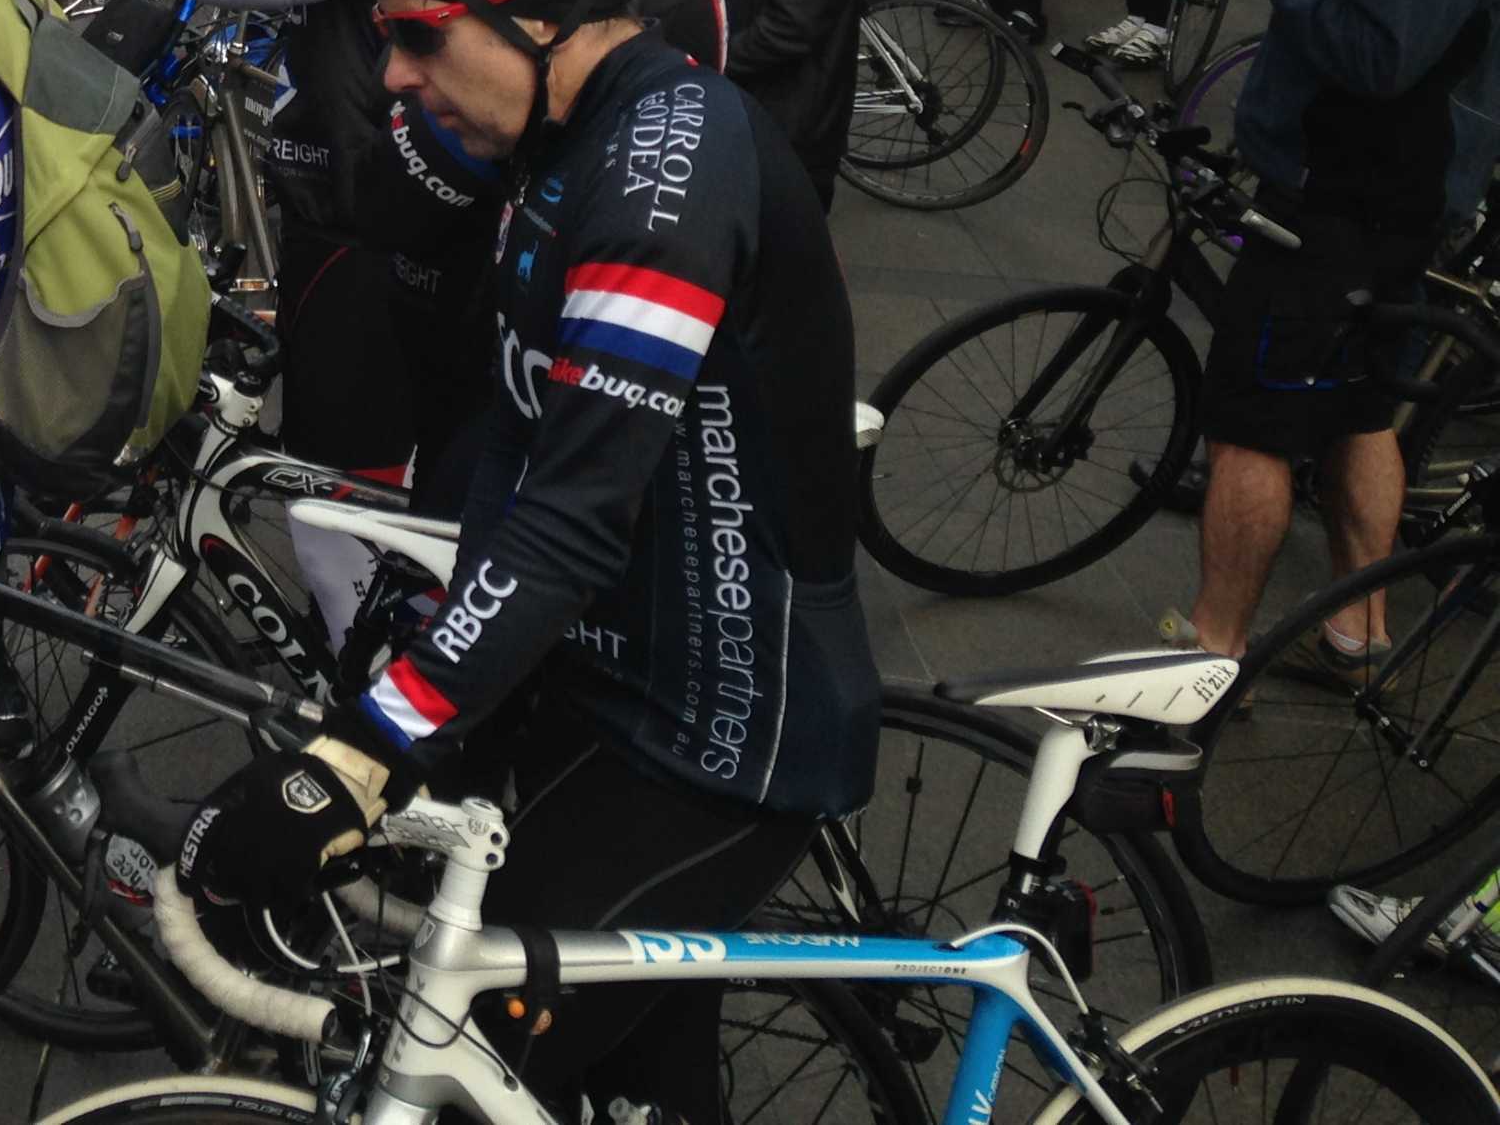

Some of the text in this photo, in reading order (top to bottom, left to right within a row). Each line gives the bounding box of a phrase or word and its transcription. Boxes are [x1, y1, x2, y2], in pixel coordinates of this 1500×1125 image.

[647, 83, 706, 232] CARROLL
[431, 560, 519, 664] RBCC
[695, 385, 756, 781] marchesepartners
[180, 808, 221, 879] HESTRA
